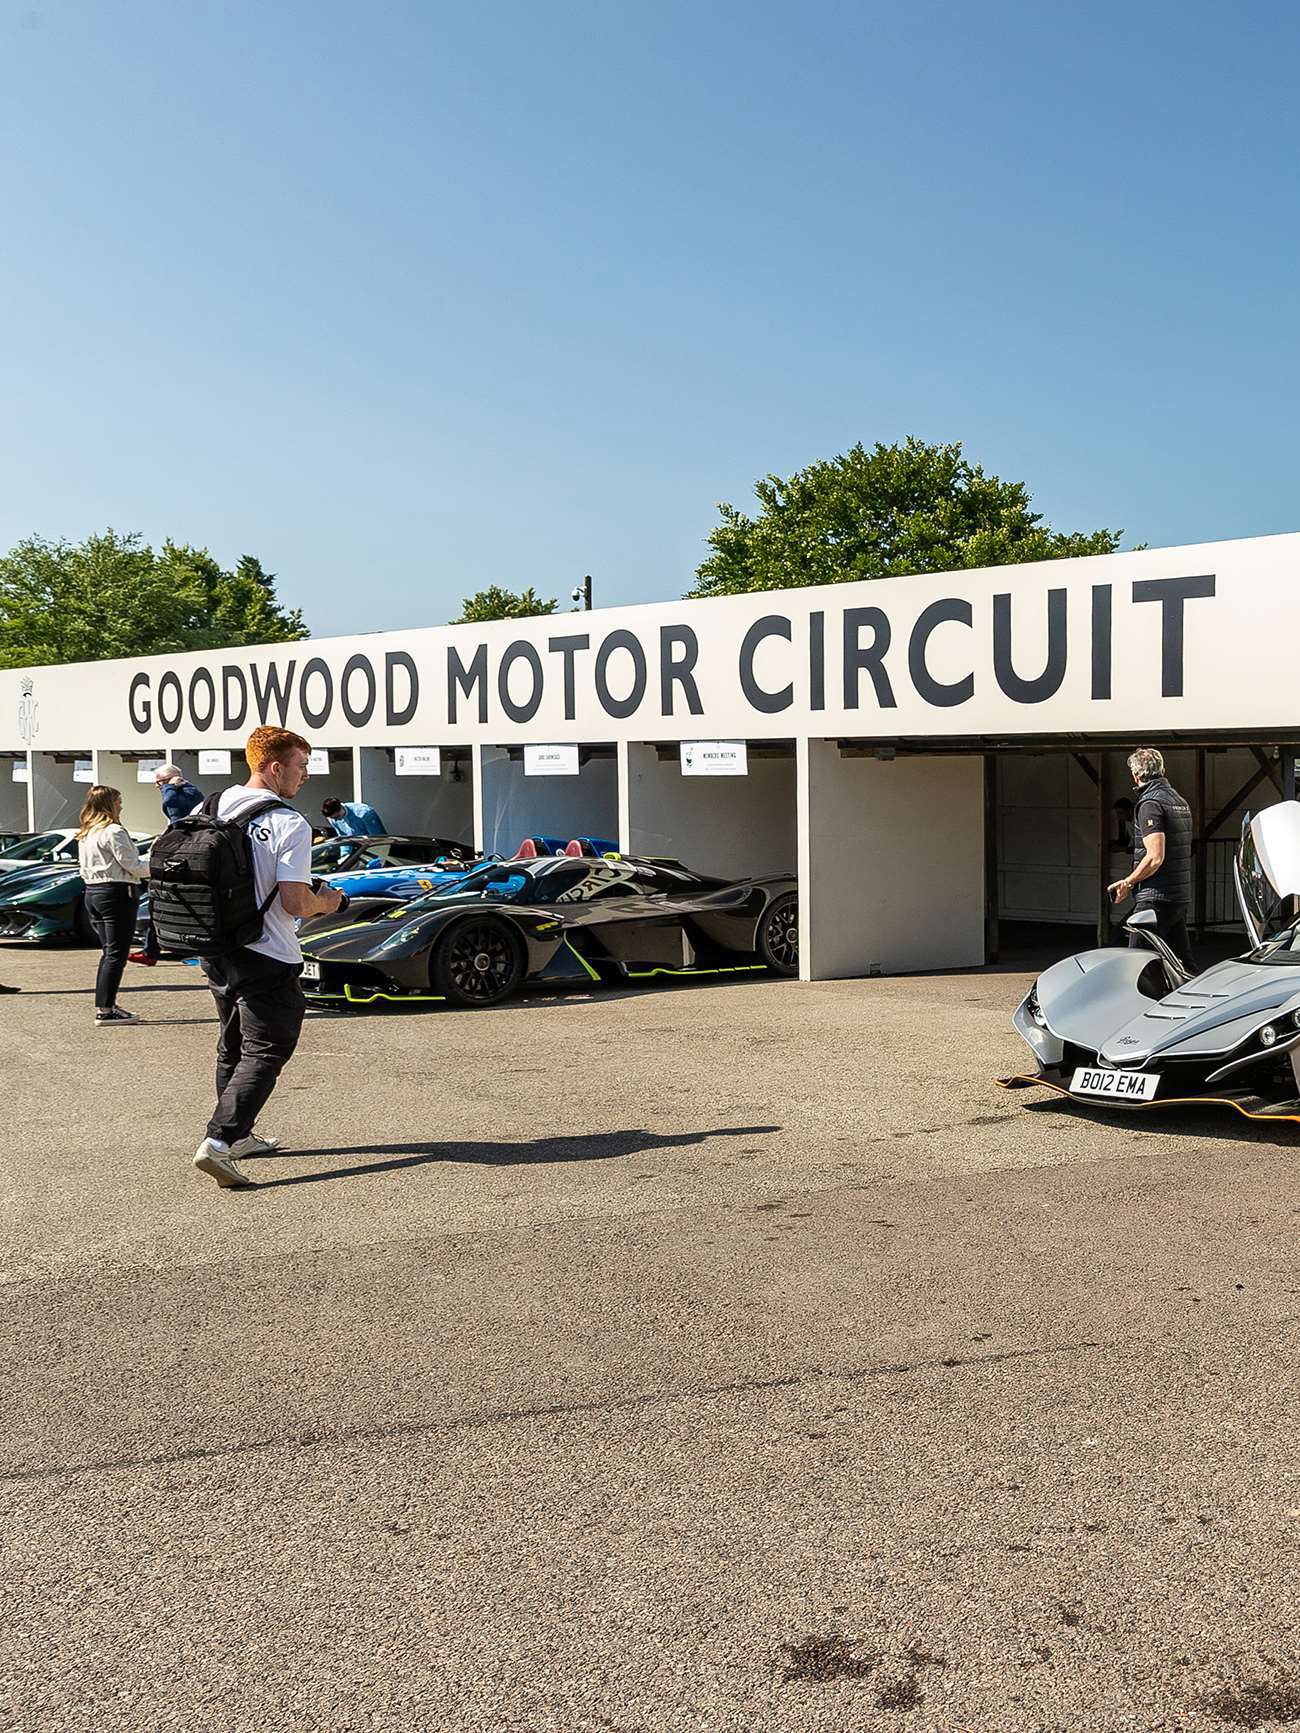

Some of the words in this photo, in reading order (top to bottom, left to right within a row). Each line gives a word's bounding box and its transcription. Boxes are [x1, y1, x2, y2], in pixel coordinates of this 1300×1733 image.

[128, 650, 420, 735] GOODWOOD
[447, 624, 705, 725] MOTOR
[738, 573, 1217, 714] CIRCUIT
[1080, 1071, 1115, 1091] BO12
[1116, 1075, 1147, 1095] EMA
